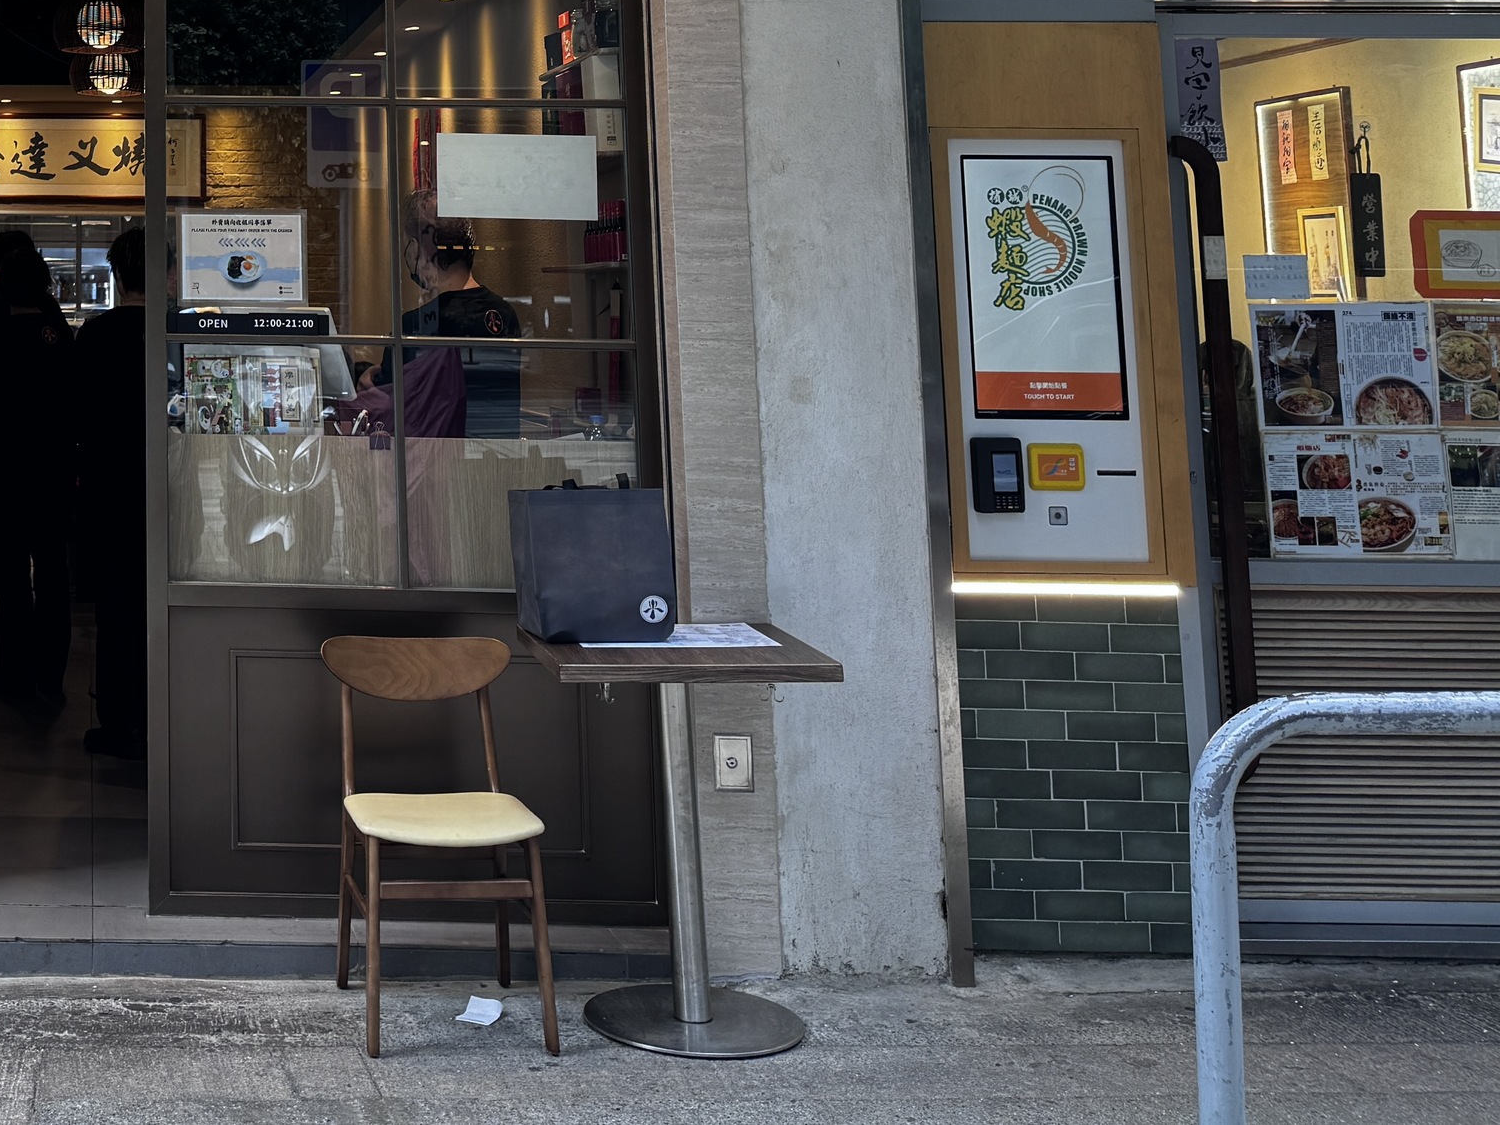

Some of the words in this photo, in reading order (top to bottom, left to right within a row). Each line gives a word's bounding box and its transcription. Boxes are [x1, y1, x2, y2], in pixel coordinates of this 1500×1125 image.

[1032, 193, 1073, 218] PENANG
[1069, 217, 1088, 256] PRAWN
[1361, 193, 1380, 270] 營業中
[1054, 258, 1086, 292] NOODLE
[1023, 285, 1054, 297] SHOP
[198, 318, 228, 328] OPEN
[254, 319, 314, 328] 12:00-21:00
